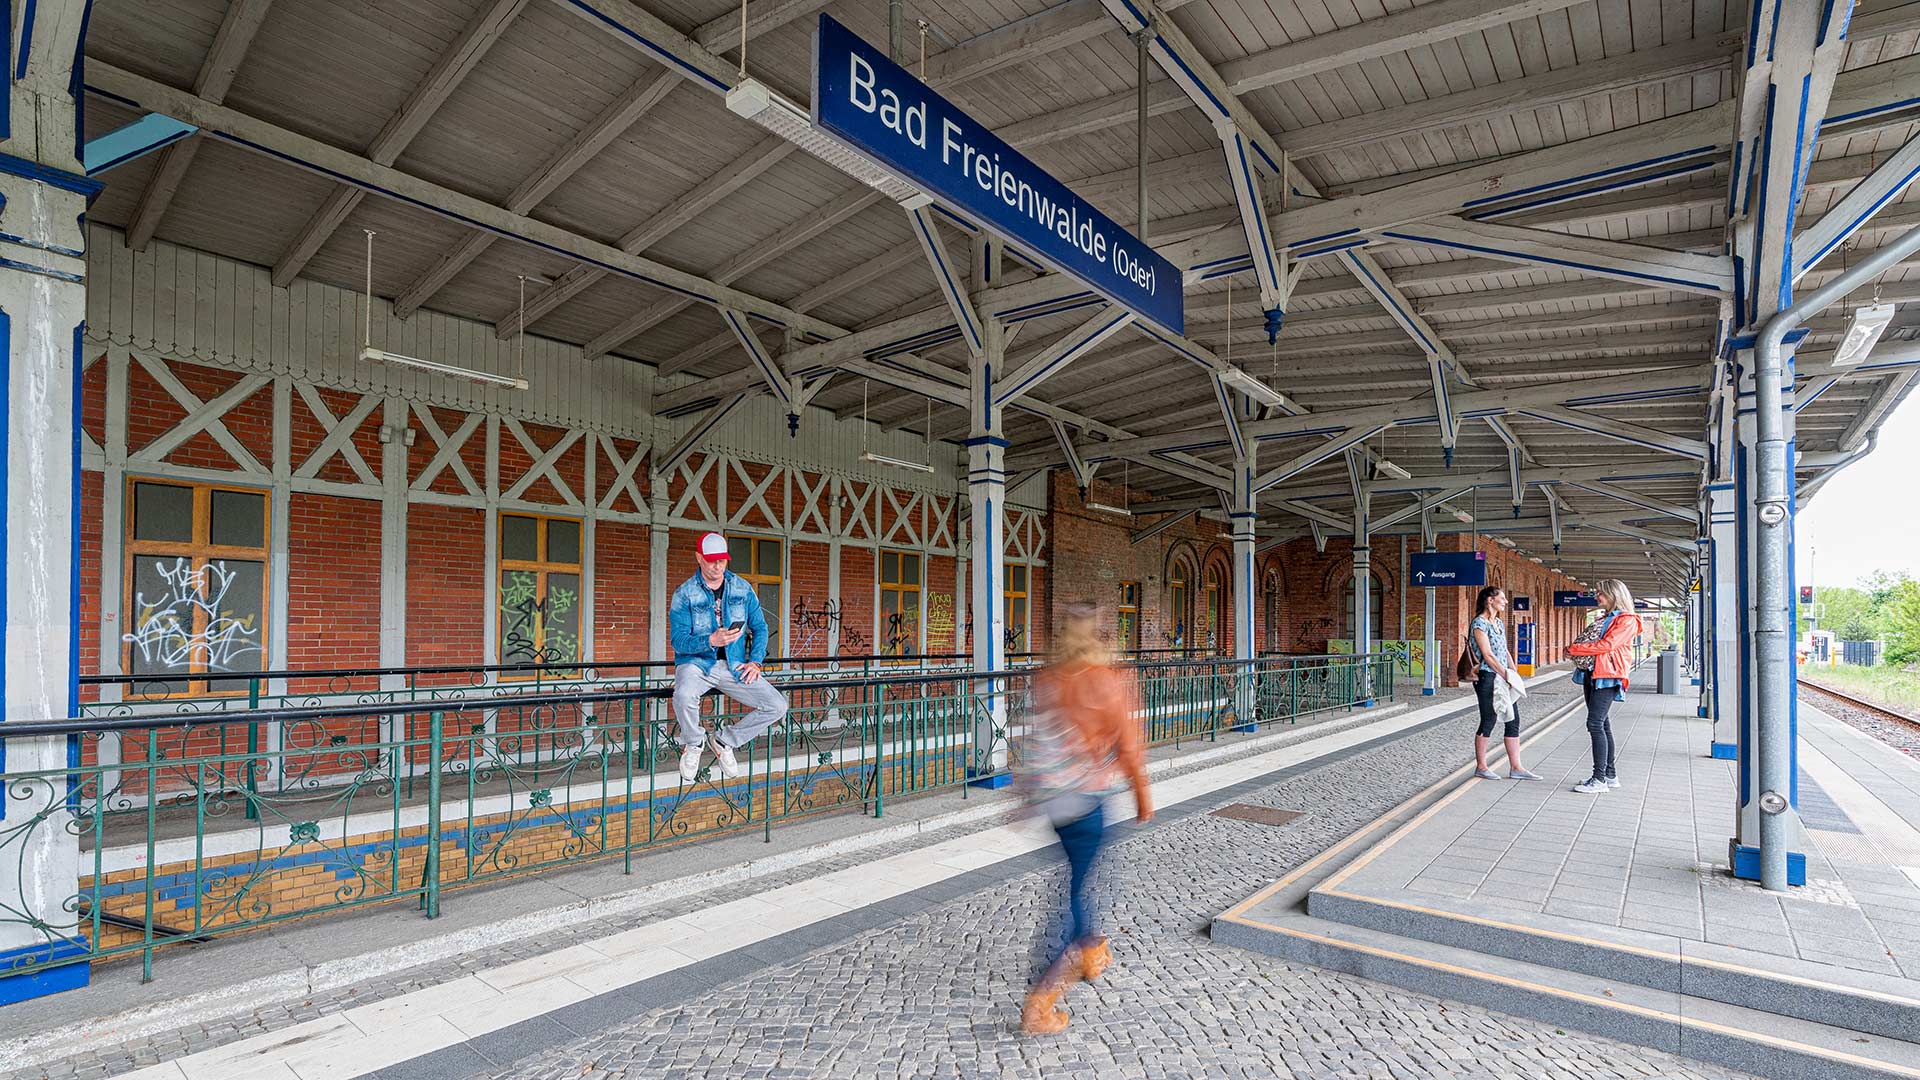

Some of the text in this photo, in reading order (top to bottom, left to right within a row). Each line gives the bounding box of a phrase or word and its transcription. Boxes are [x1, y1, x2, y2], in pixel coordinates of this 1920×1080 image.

[850, 51, 1156, 296] Bad Freienwalde (Oder)
